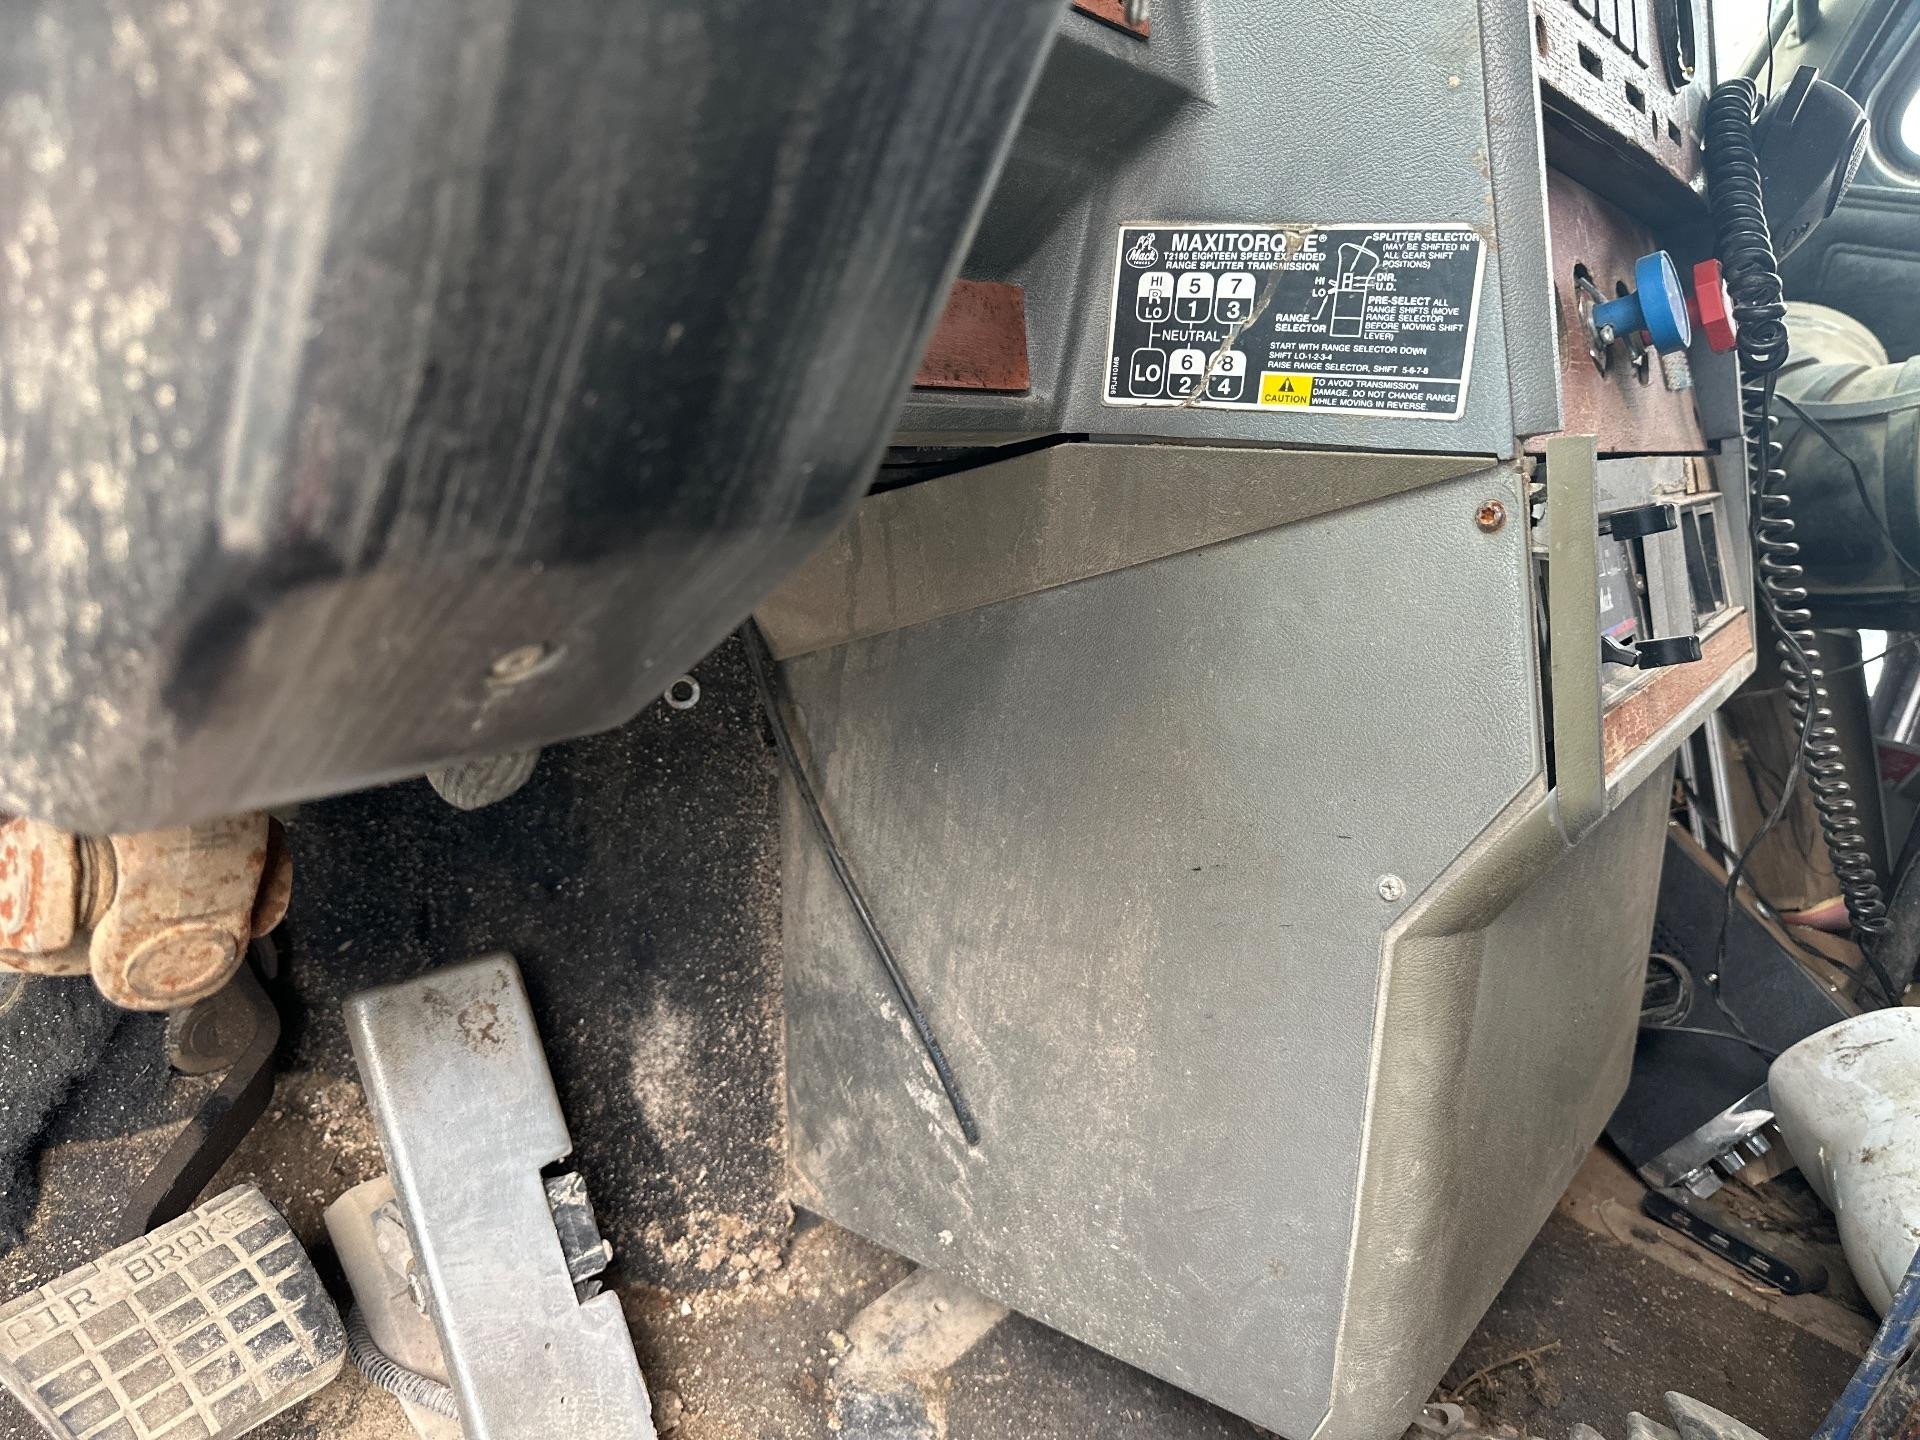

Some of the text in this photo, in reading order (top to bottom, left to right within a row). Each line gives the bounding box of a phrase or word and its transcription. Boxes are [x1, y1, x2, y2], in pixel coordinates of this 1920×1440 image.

[1171, 233, 1318, 252] MAXITORQE
[1372, 232, 1480, 242] SPLITTER SELECTOR
[1383, 243, 1470, 251] (MAY BE SHIFTED IN
[1129, 249, 1156, 261] Mack
[1163, 252, 1327, 261] T2180 EIGHTEEN SPEED EXENDED
[1402, 252, 1426, 260] GEAR
[1428, 252, 1453, 260] SHIFT
[1165, 261, 1320, 271] RANGE SPLITTER TRANSMISSION
[1382, 260, 1431, 269] POSITIONS)
[1151, 276, 1163, 286] HI
[1314, 276, 1325, 285] HI
[1376, 273, 1397, 281] DIR.
[1189, 278, 1201, 294] 5
[1231, 278, 1242, 294] 7
[1148, 289, 1162, 304] R
[1312, 288, 1326, 297] LO
[1368, 296, 1431, 305] PRE-SELECT
[1145, 307, 1162, 318] LO
[1188, 300, 1197, 317] 1
[1226, 301, 1240, 318] 3
[1367, 305, 1460, 316] RANGE SHIFTS (MOVE
[1276, 313, 1310, 323] RANGE
[1365, 313, 1443, 323] RANGE SELECTOR
[1274, 323, 1327, 333] SELECTOR
[1364, 321, 1464, 332] BEFORE MOVING SHIFT
[1162, 329, 1220, 342] NEUTRAL
[1363, 332, 1395, 341] LEVER)
[1269, 342, 1428, 355] START WITH RANGE SELECTOR DOWN
[1268, 351, 1333, 361] SHIFT LO-1-2-3-4
[1181, 355, 1193, 370] 6
[1221, 355, 1234, 371] 8
[1267, 361, 1292, 369] RAISE
[1293, 361, 1322, 370] RANGE
[1373, 365, 1398, 374] SHIFT
[1402, 366, 1429, 375] 5-6-7-8
[1134, 364, 1161, 382] LO
[1179, 376, 1192, 393] 2
[1217, 378, 1231, 394] 4
[1314, 378, 1419, 390] TO AVOID TRANSMISSION
[1264, 393, 1307, 404] CAUTION
[1352, 389, 1365, 398] DO
[1367, 390, 1386, 399] NOT
[1388, 391, 1424, 401] CHANGE
[1425, 393, 1457, 402] RANGE
[1311, 397, 1337, 406] WHILE
[1339, 398, 1373, 408] MOVING
[1375, 400, 1385, 408] IN
[7, 1205, 257, 1346] AIR BRAKE
